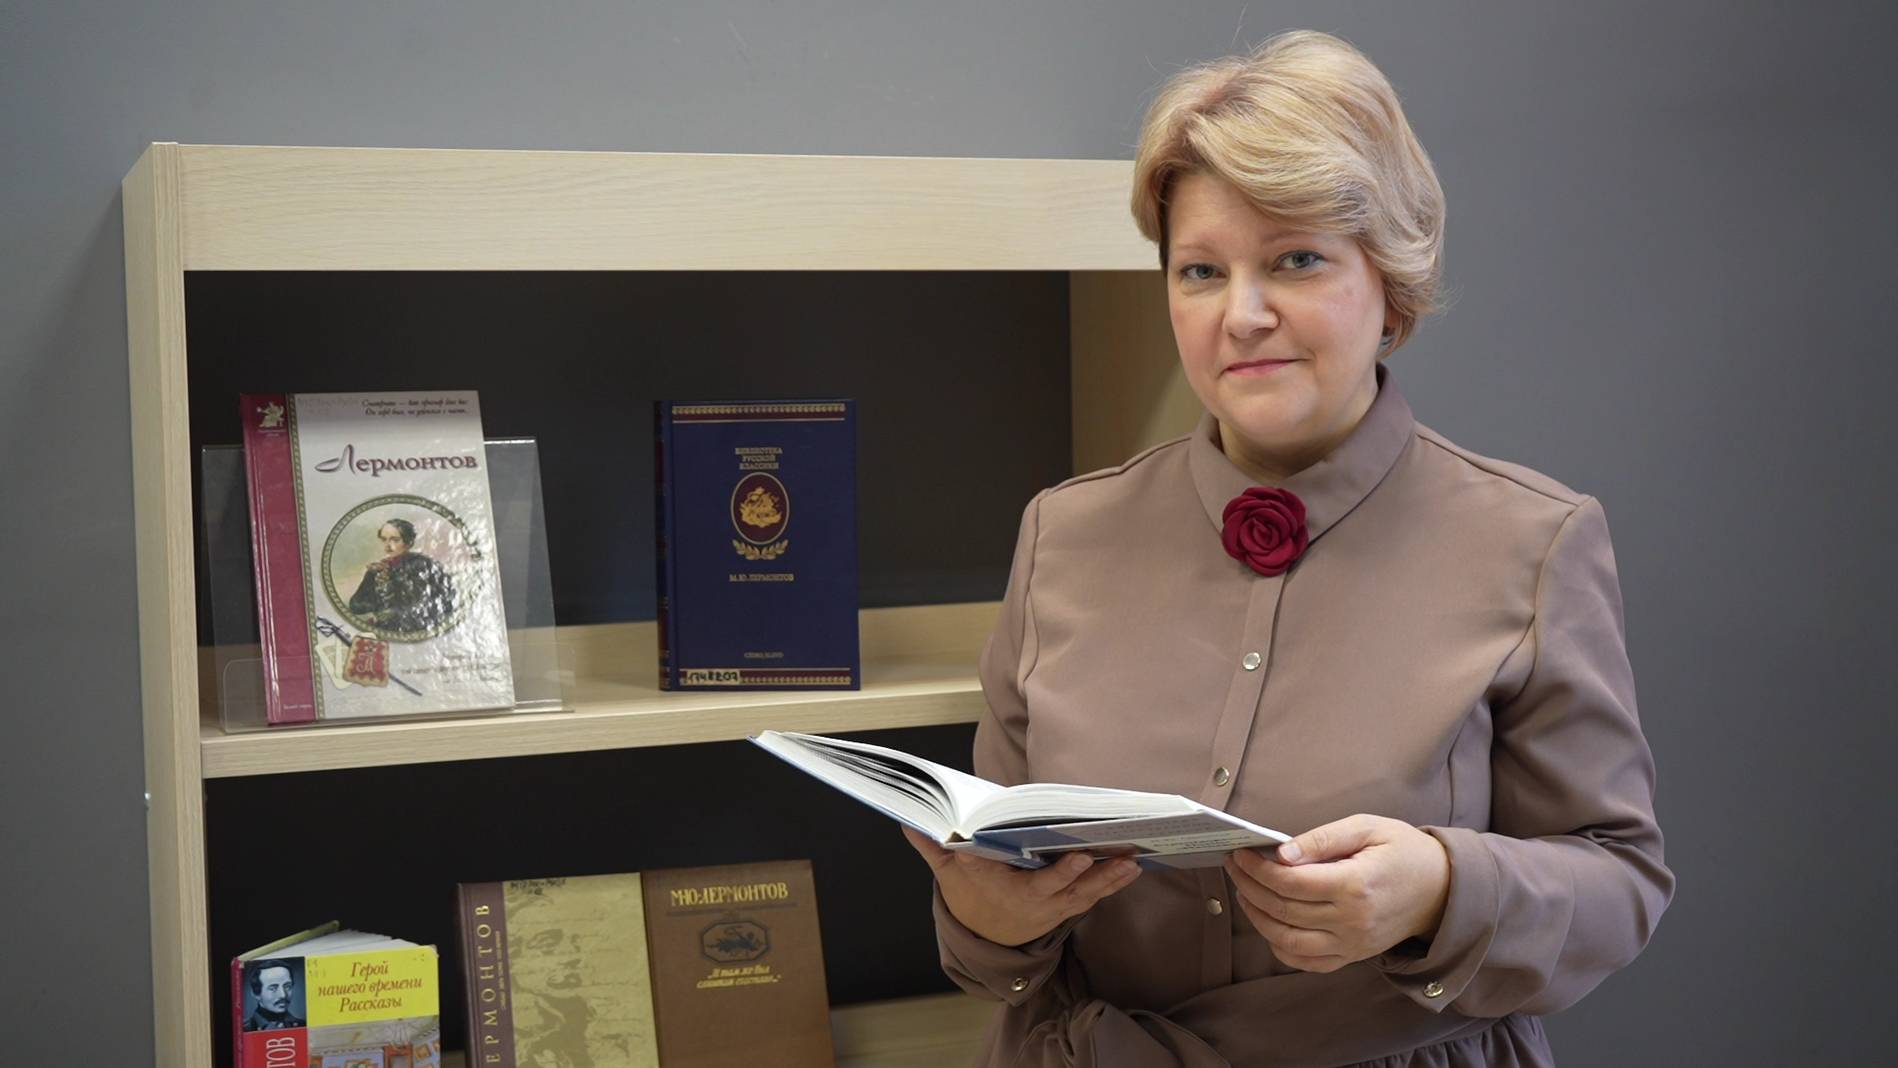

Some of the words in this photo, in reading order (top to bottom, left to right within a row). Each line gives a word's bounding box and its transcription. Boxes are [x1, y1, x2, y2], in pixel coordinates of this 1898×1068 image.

[314, 443, 478, 478] Лермонтов
[351, 961, 389, 978] Герой
[317, 983, 366, 998] нашего
[369, 977, 423, 997] времени
[339, 995, 403, 1013] Рассказы
